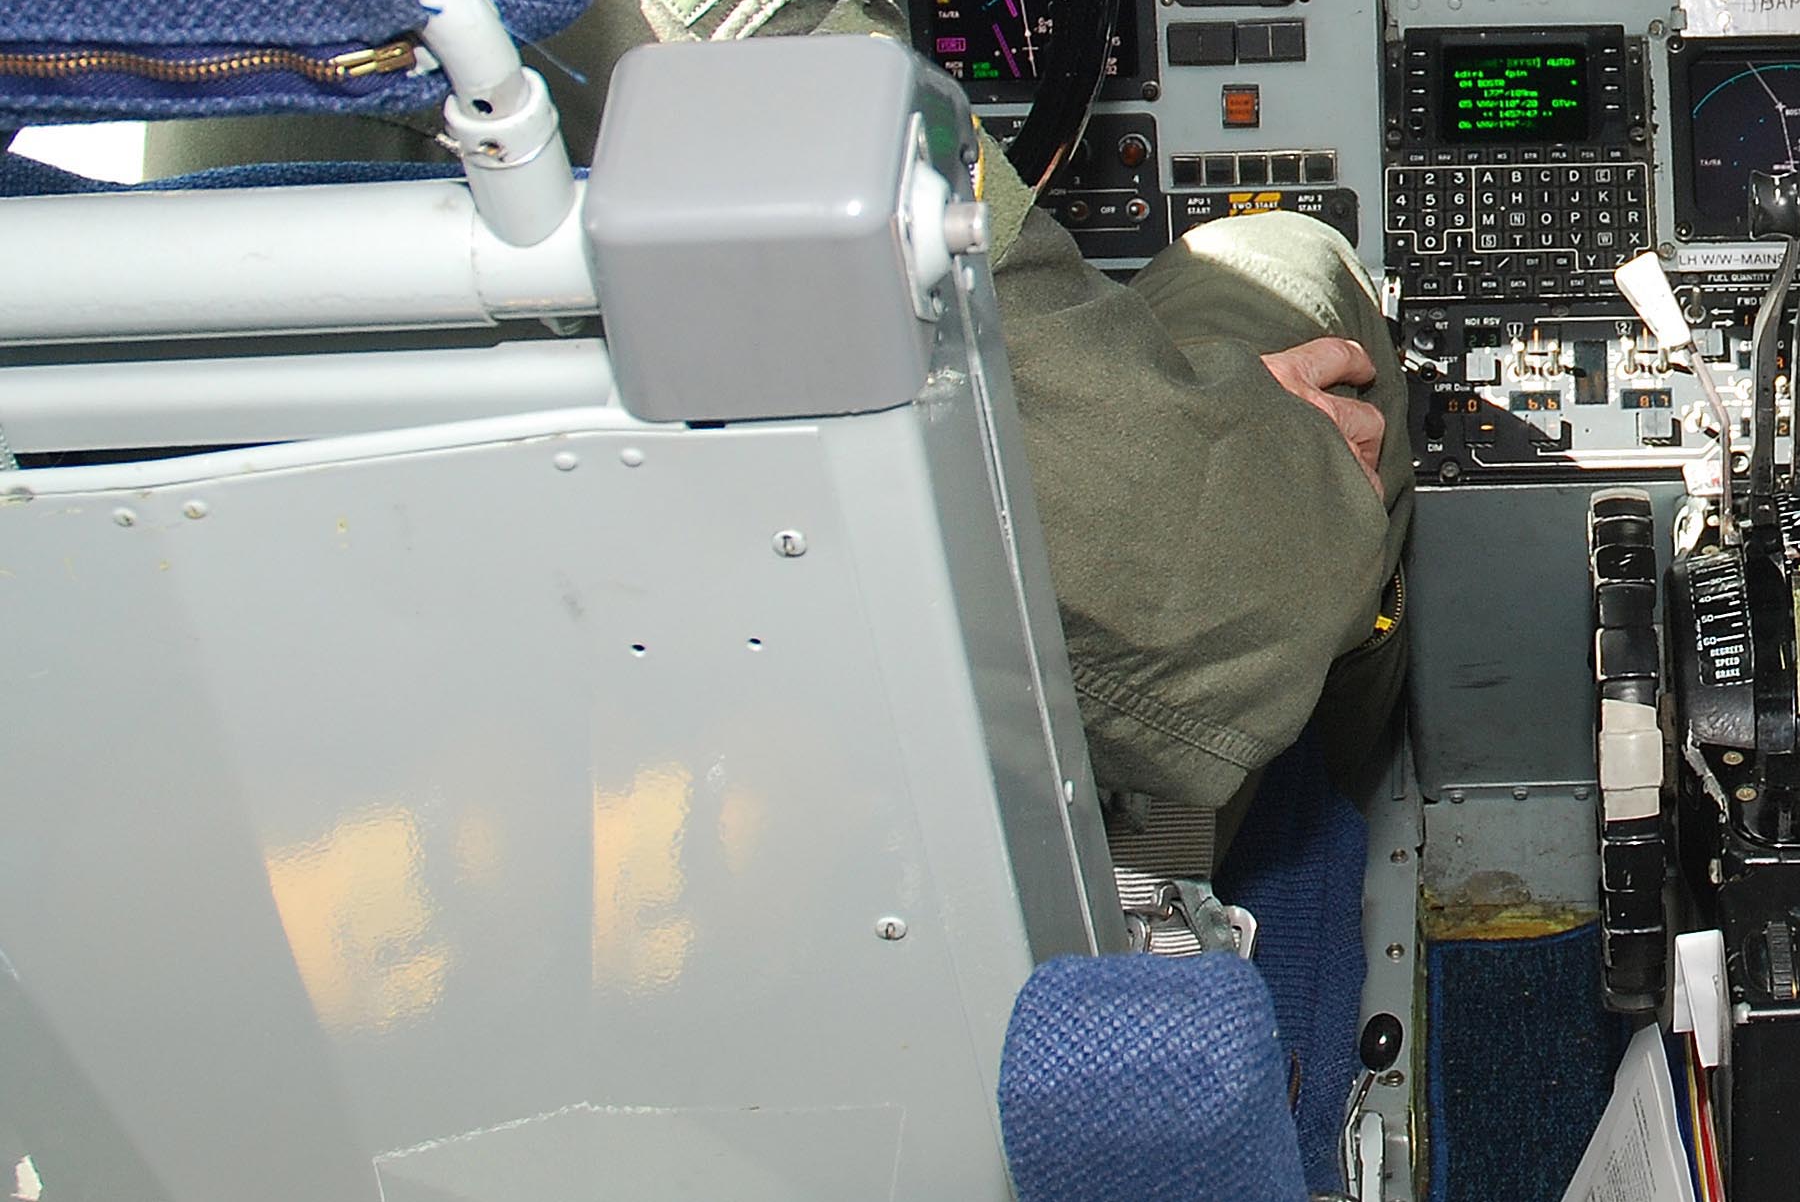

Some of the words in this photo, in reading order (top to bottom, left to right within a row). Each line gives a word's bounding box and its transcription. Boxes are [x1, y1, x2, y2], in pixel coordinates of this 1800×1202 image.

[1425, 173, 1435, 185] 2
[1454, 173, 1464, 184] 3
[1483, 172, 1494, 183] A
[1512, 171, 1522, 182] B
[1541, 171, 1551, 181] C
[1569, 170, 1580, 181] D
[1256, 201, 1278, 209] START
[1396, 195, 1406, 205] 4
[1426, 194, 1435, 205] 5
[1454, 193, 1464, 204] 6
[1397, 216, 1406, 227] 7
[1425, 216, 1435, 226] 8
[1454, 215, 1464, 226] 9
[1678, 255, 1697, 266] LH
[1708, 274, 1729, 282] FUEL
[1731, 273, 1770, 282] QUANTITY
[1710, 645, 1744, 657] DEGREES
[1715, 656, 1740, 667] SPEED
[1715, 666, 1741, 678] BRAKE
